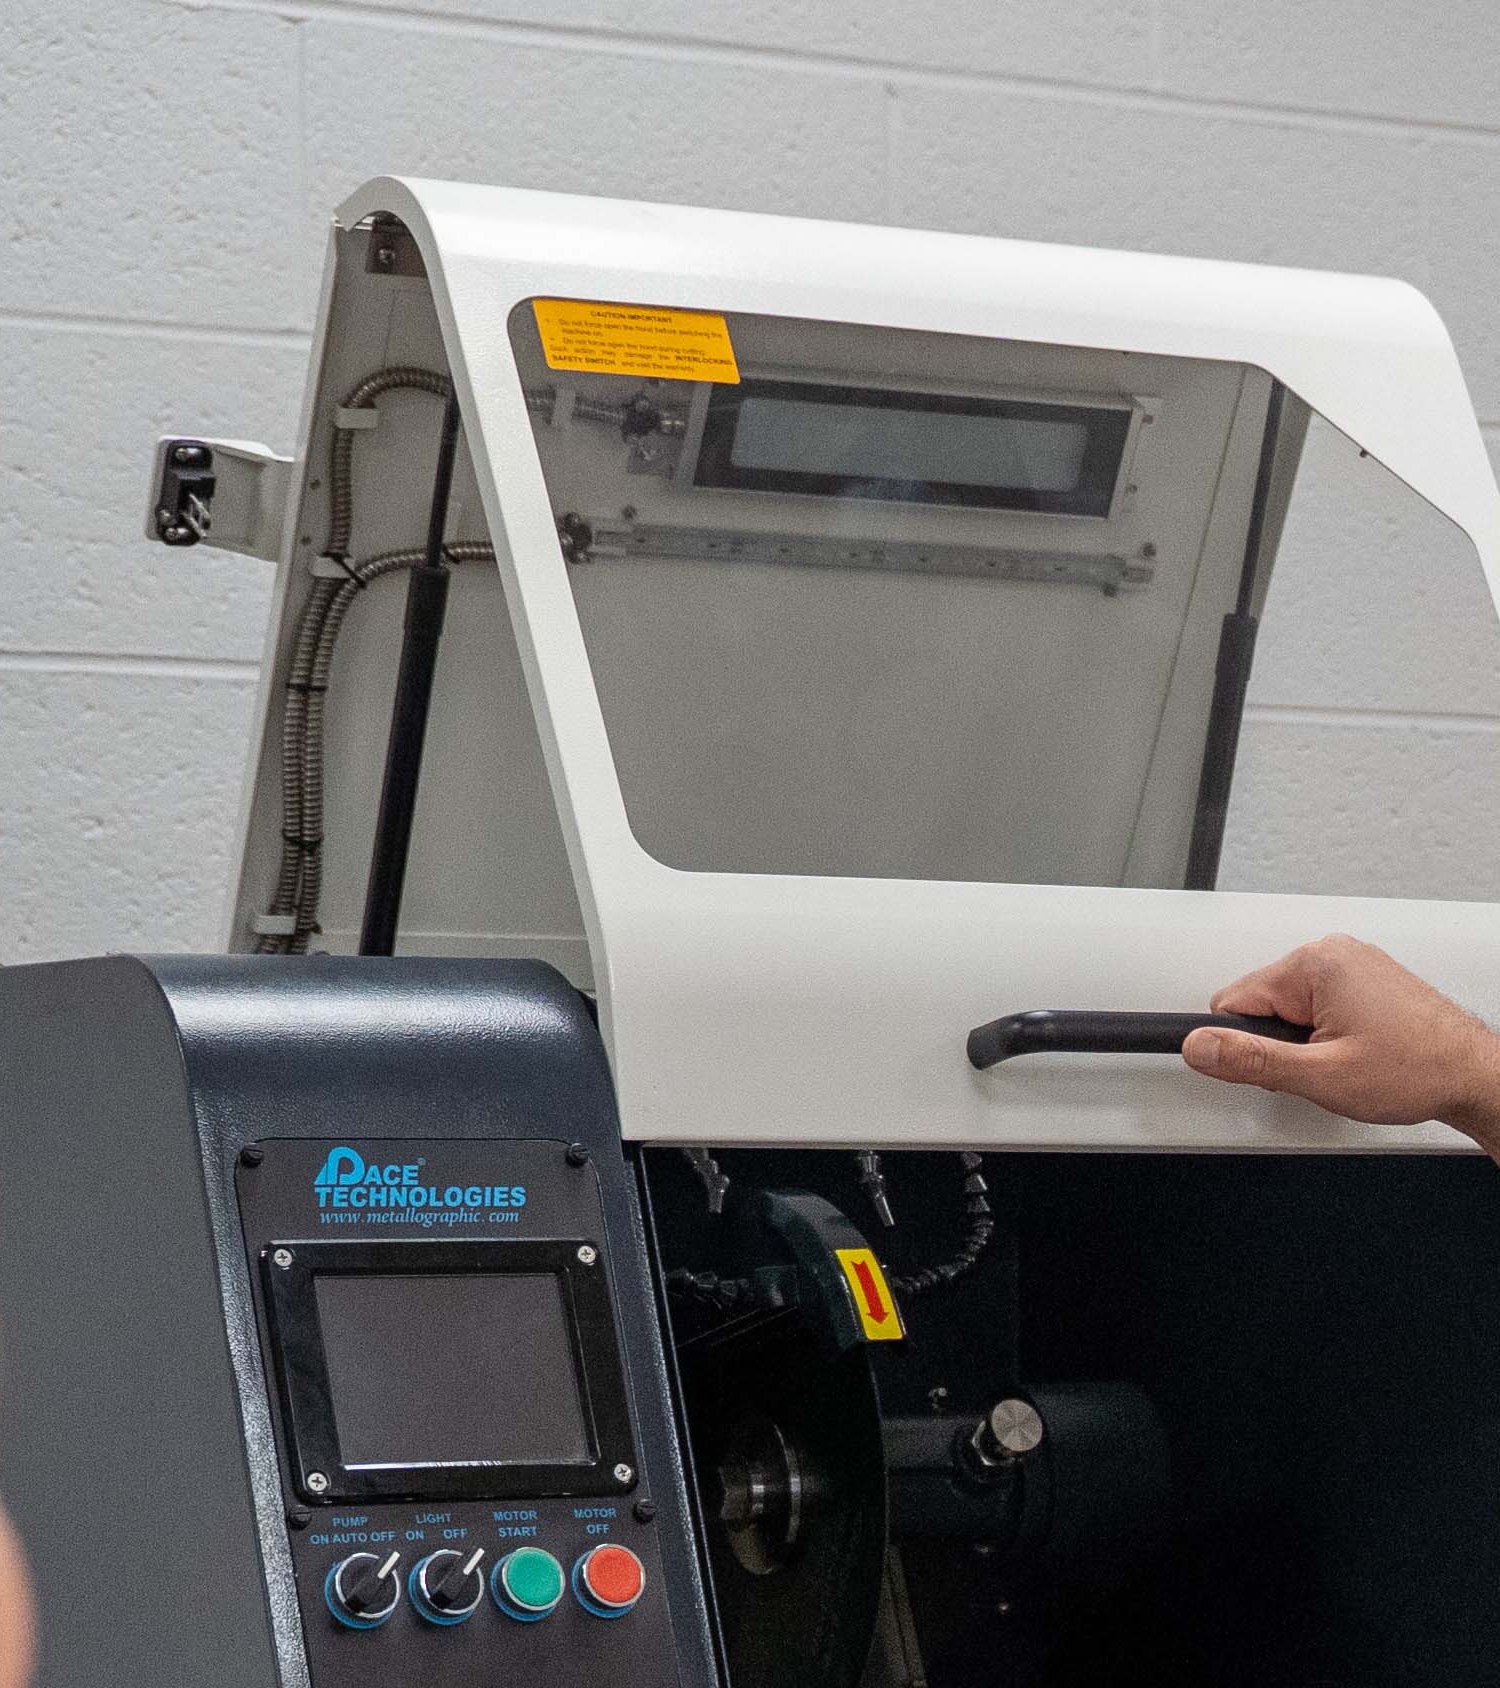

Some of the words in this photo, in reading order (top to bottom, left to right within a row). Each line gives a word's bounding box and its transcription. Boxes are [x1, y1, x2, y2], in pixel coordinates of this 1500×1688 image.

[314, 1186, 526, 1208] TECHNOLOGIES
[415, 1513, 451, 1524] LIGHT
[493, 1510, 538, 1521] MOTOR
[574, 1507, 617, 1519] MOTOR
[332, 1516, 369, 1527] PUMP
[405, 1530, 424, 1541] ON
[443, 1528, 468, 1539] OFF
[498, 1526, 537, 1538] START
[586, 1523, 610, 1535] OFF
[309, 1534, 329, 1545] ON
[332, 1532, 367, 1544] AUTO
[370, 1531, 396, 1542] OFF
